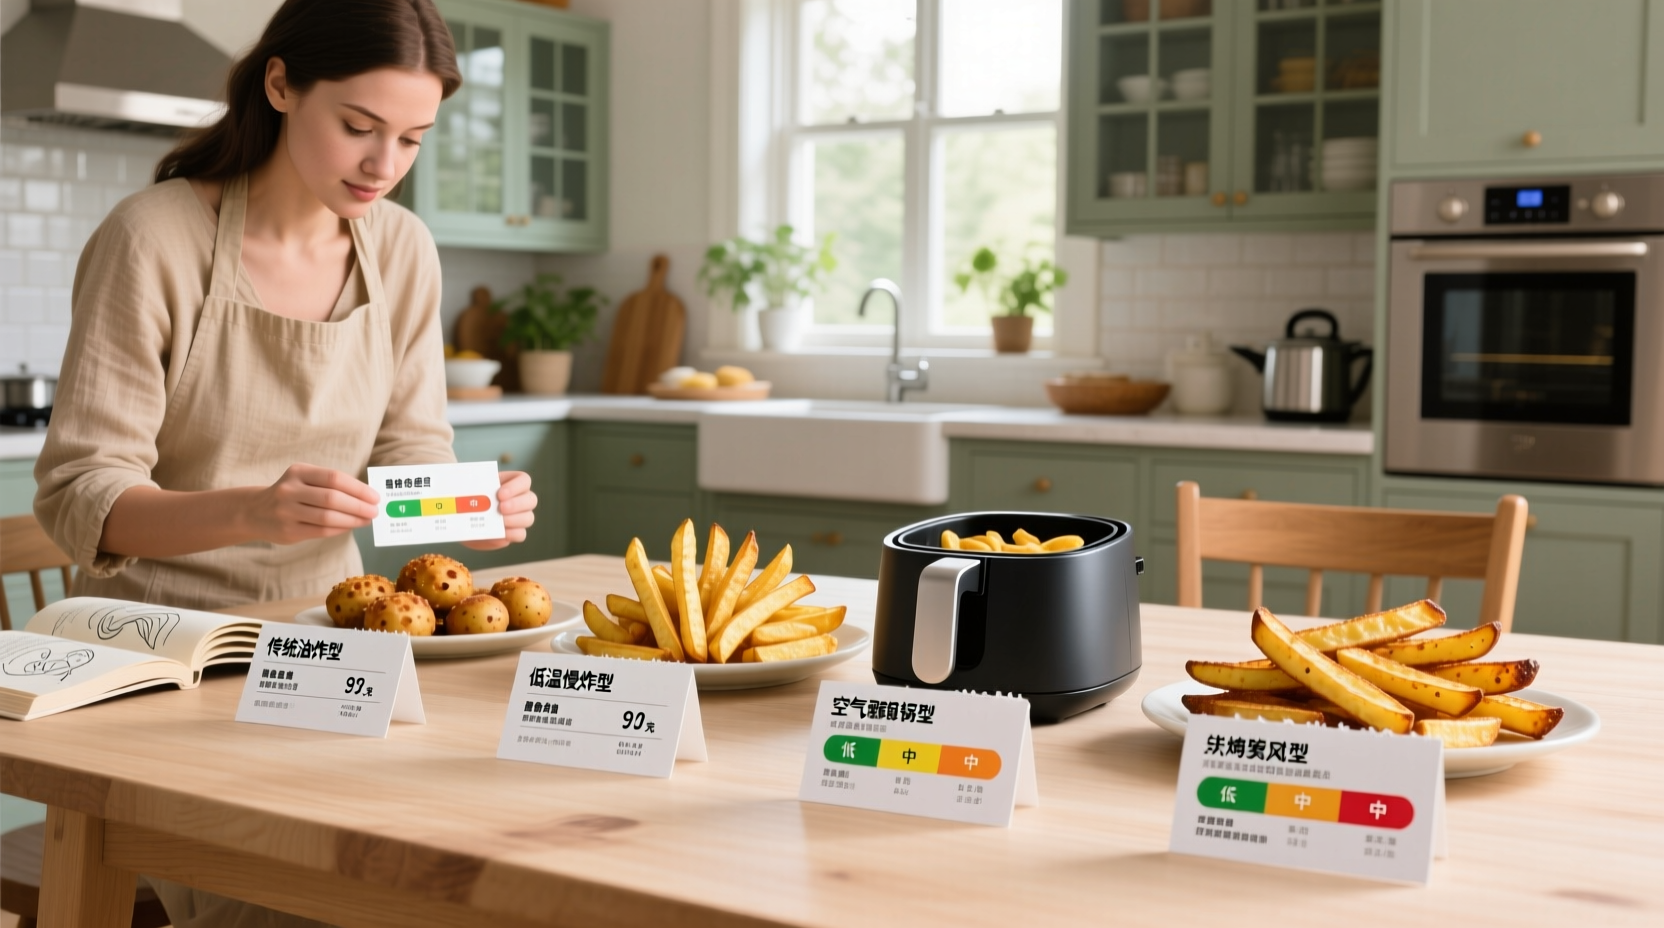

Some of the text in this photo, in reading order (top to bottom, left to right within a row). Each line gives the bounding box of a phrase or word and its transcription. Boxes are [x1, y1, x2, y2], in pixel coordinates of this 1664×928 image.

[529, 666, 614, 693] 低温慢炸型
[902, 748, 917, 765] 中
[964, 753, 979, 770] 中
[1294, 791, 1312, 812] 中
[1369, 800, 1388, 821] 中
